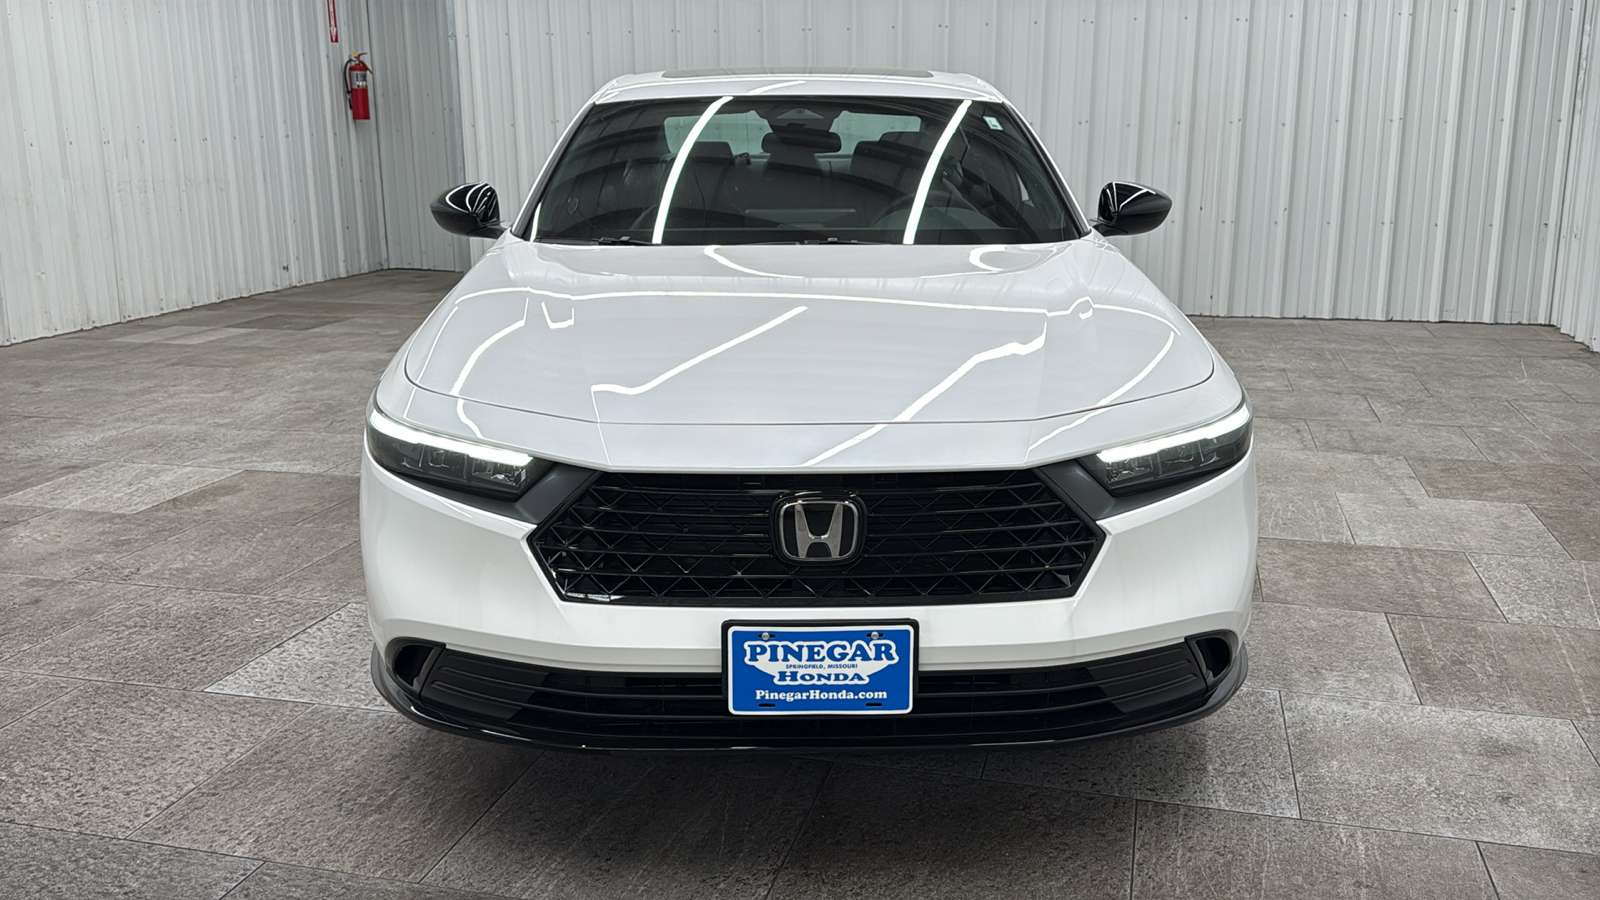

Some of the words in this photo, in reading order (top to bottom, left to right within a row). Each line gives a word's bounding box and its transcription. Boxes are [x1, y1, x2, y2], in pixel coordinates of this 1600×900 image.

[747, 642, 896, 662] PINEGAR
[777, 671, 866, 682] HONDA
[755, 689, 887, 702] PinegarHonda.com
